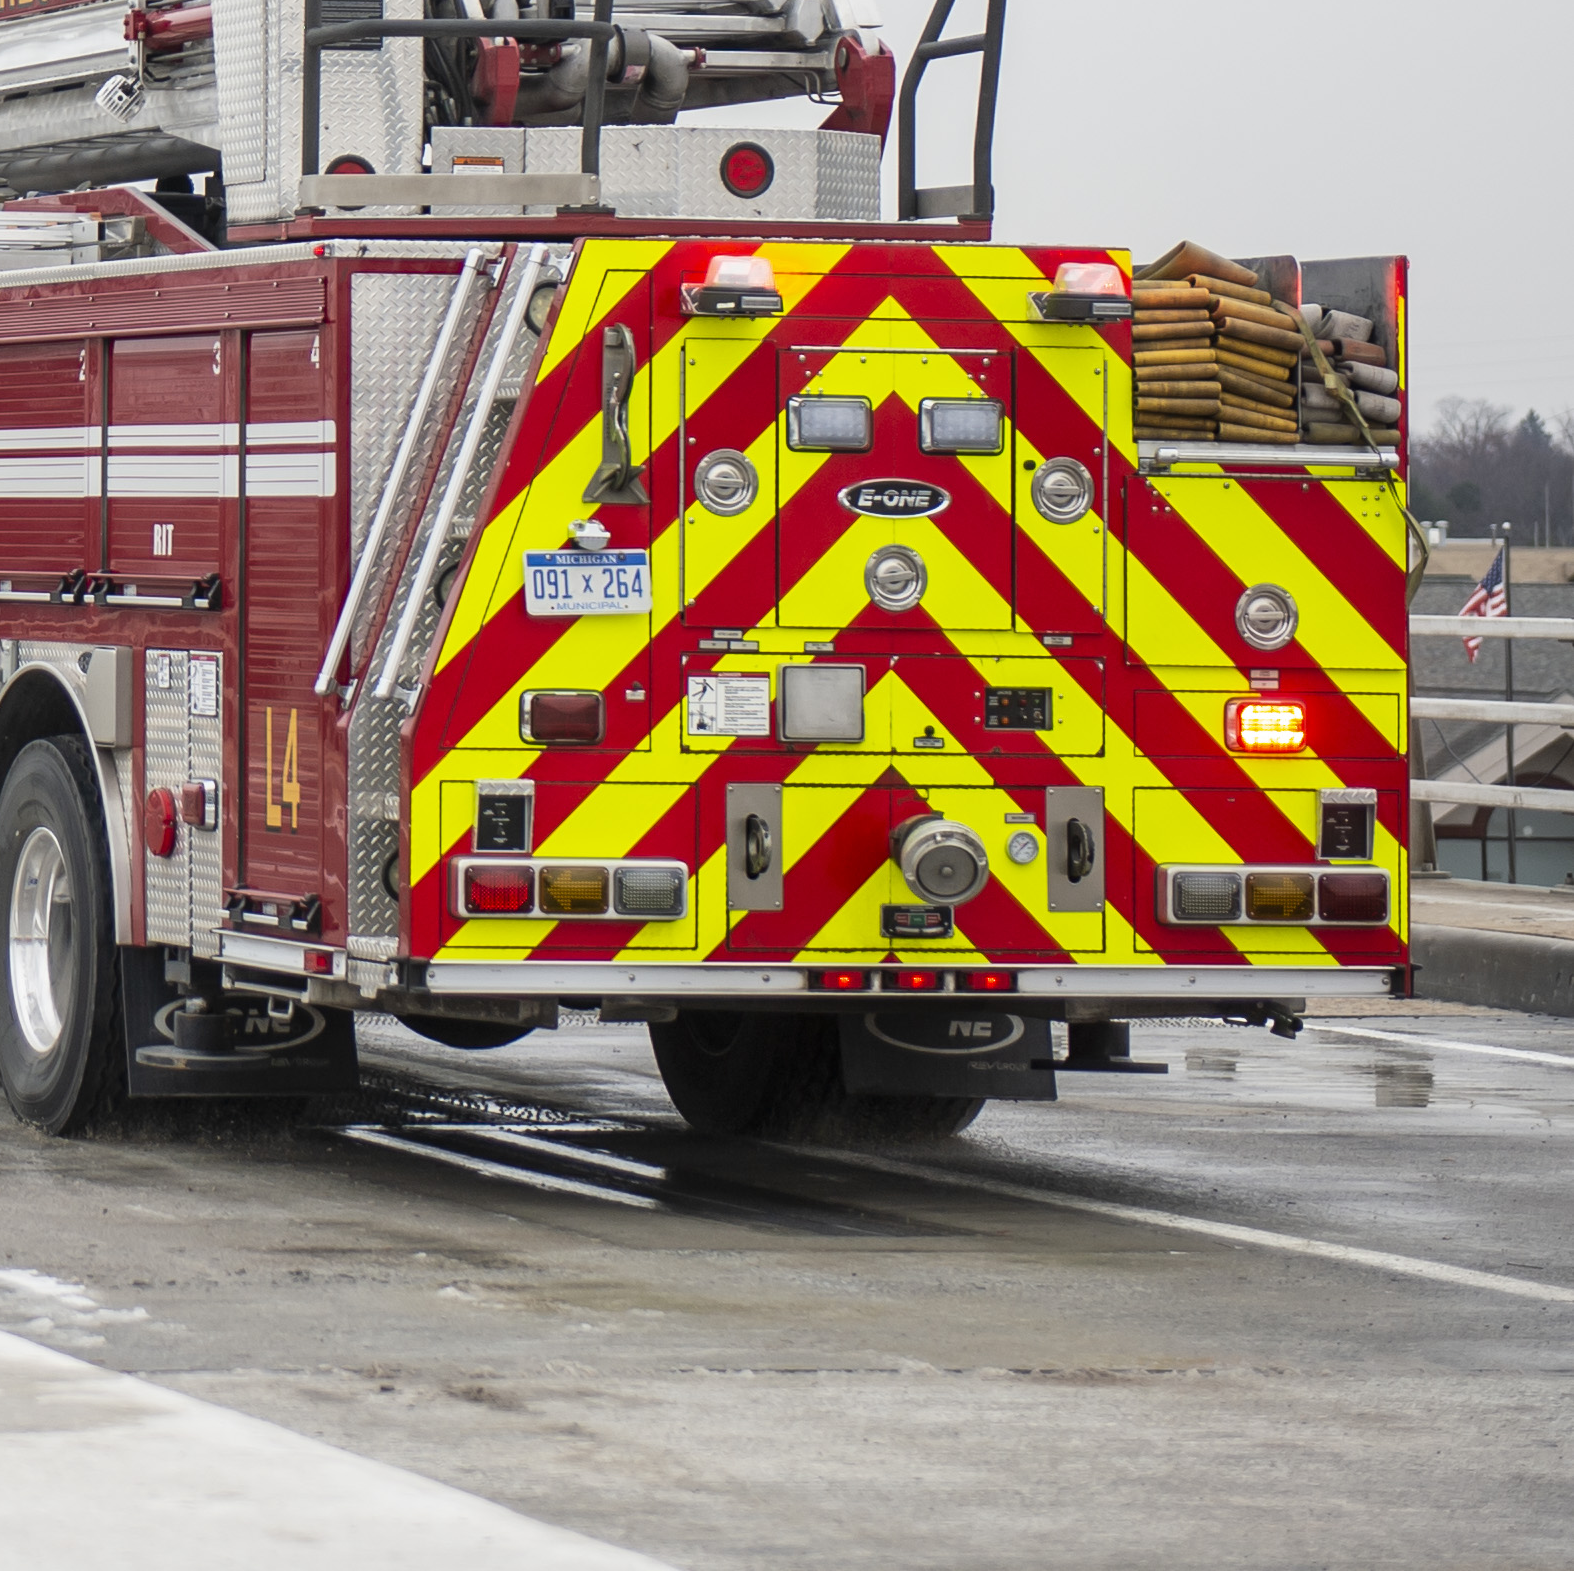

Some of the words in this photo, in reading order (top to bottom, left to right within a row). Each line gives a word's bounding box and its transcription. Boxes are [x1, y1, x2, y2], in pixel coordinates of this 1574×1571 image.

[858, 489, 932, 507] E-ONE
[154, 523, 174, 555] RIT
[556, 555, 617, 564] MICHIGAN
[533, 569, 573, 599] 091
[582, 574, 593, 593] X
[602, 568, 643, 598] 264
[557, 601, 623, 610] MUNICIPAL
[267, 707, 300, 828] L4
